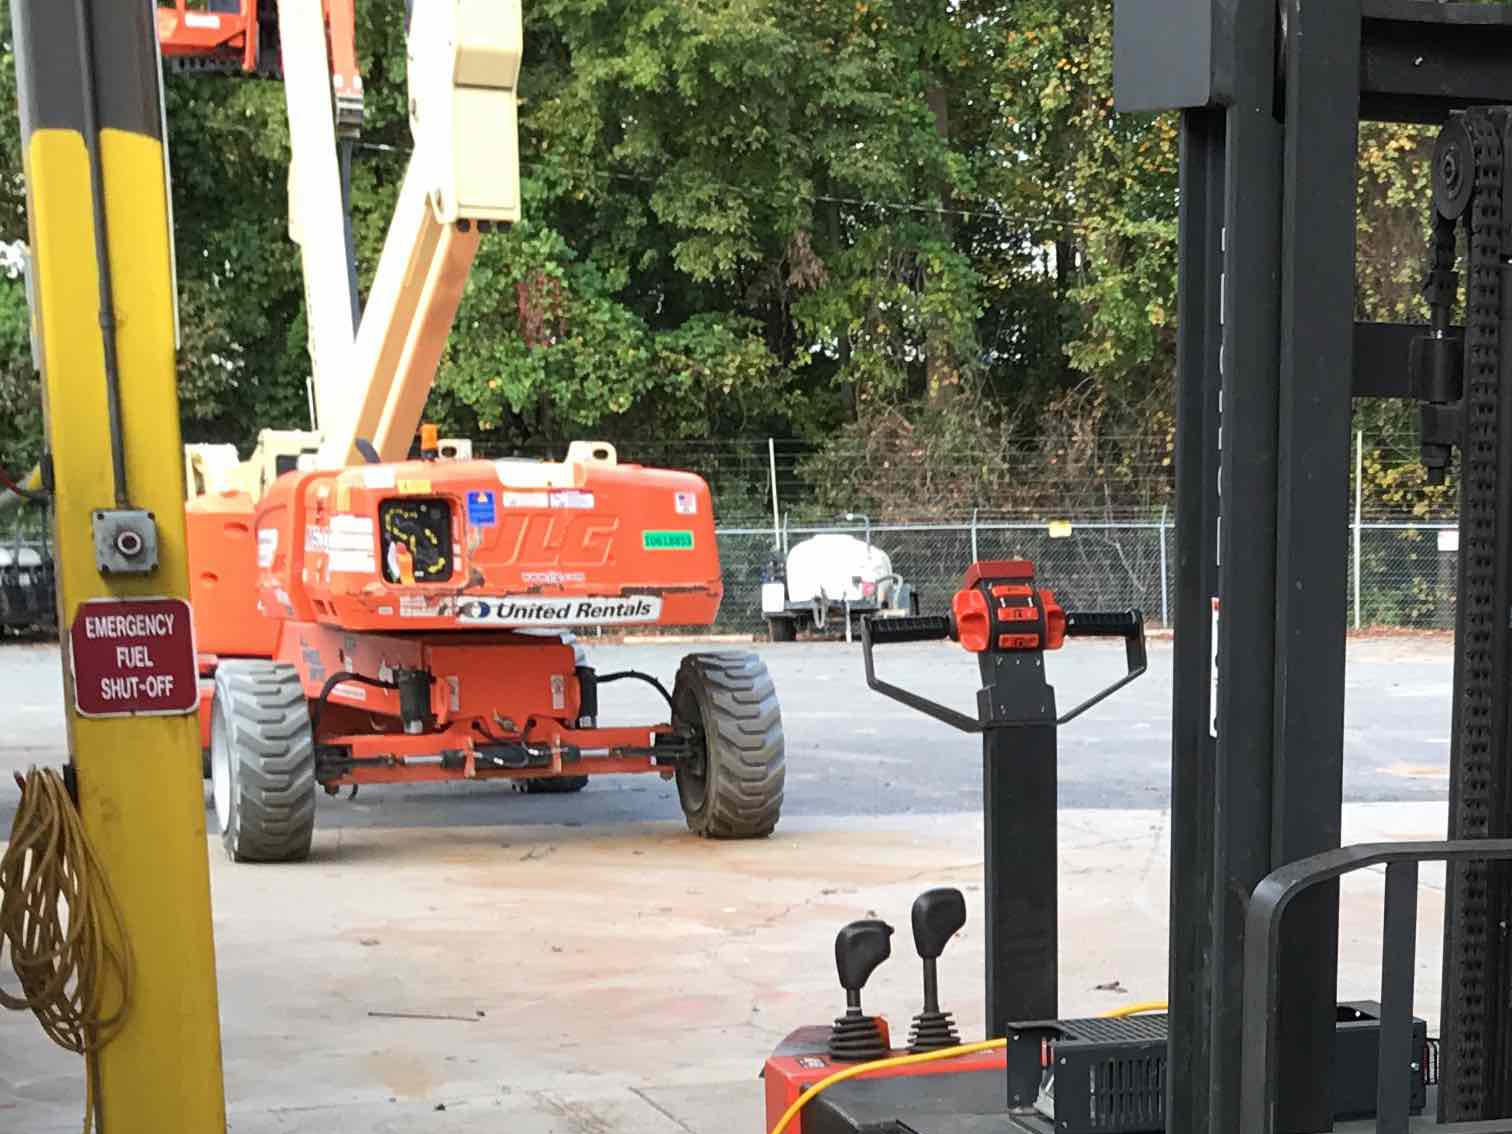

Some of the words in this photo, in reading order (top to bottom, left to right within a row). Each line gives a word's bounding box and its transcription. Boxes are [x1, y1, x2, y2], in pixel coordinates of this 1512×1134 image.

[472, 513, 620, 567] JLG
[496, 600, 571, 620] United
[576, 600, 652, 619] Rentals
[85, 614, 175, 638] EMERGENCY
[116, 646, 154, 668] FUEL
[101, 675, 174, 700] SHUT-OFF
